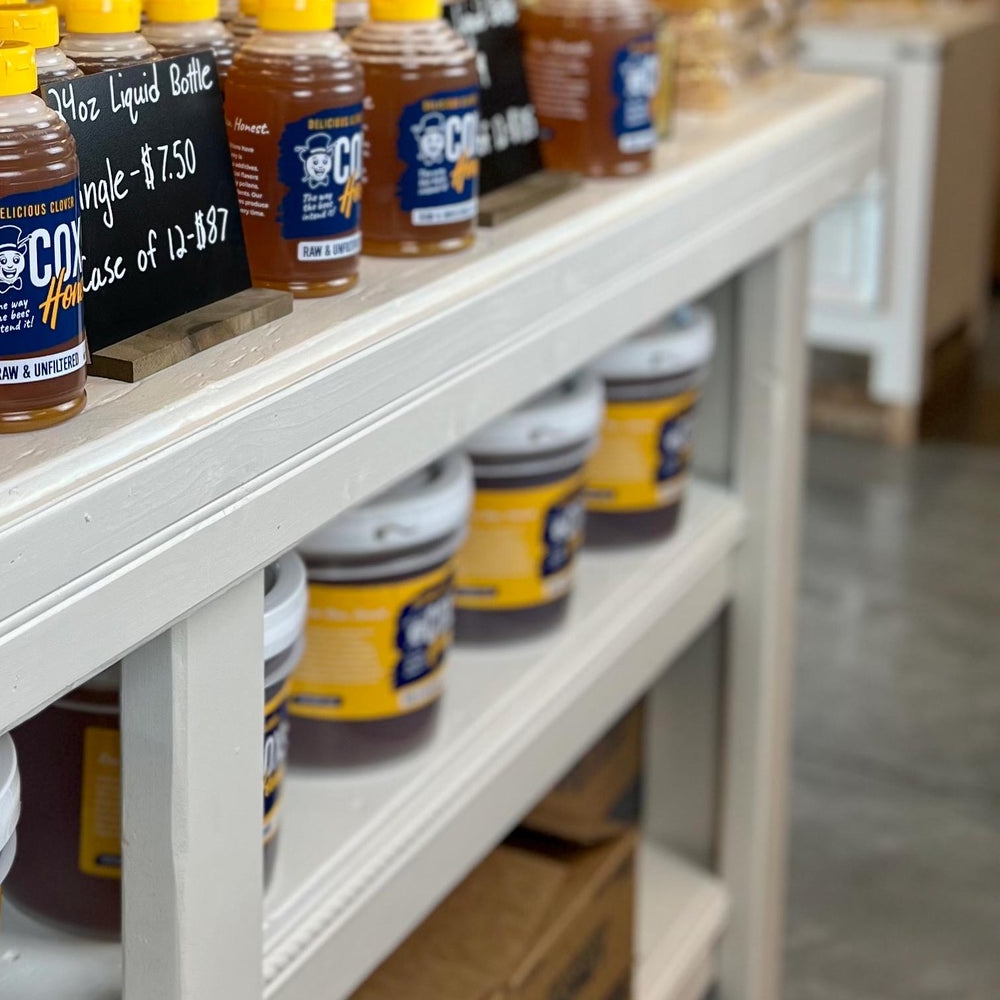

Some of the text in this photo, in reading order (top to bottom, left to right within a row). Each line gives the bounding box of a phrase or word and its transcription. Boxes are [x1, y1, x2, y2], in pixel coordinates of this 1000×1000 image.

[48, 57, 213, 124] 24oz Liquid Bottle
[49, 196, 75, 214] CLOVER
[137, 229, 157, 272] of
[11, 299, 29, 312] way
[10, 309, 30, 321] bees
[23, 315, 34, 329] it!
[23, 361, 31, 379] &
[33, 352, 80, 377] UNFILTERED
